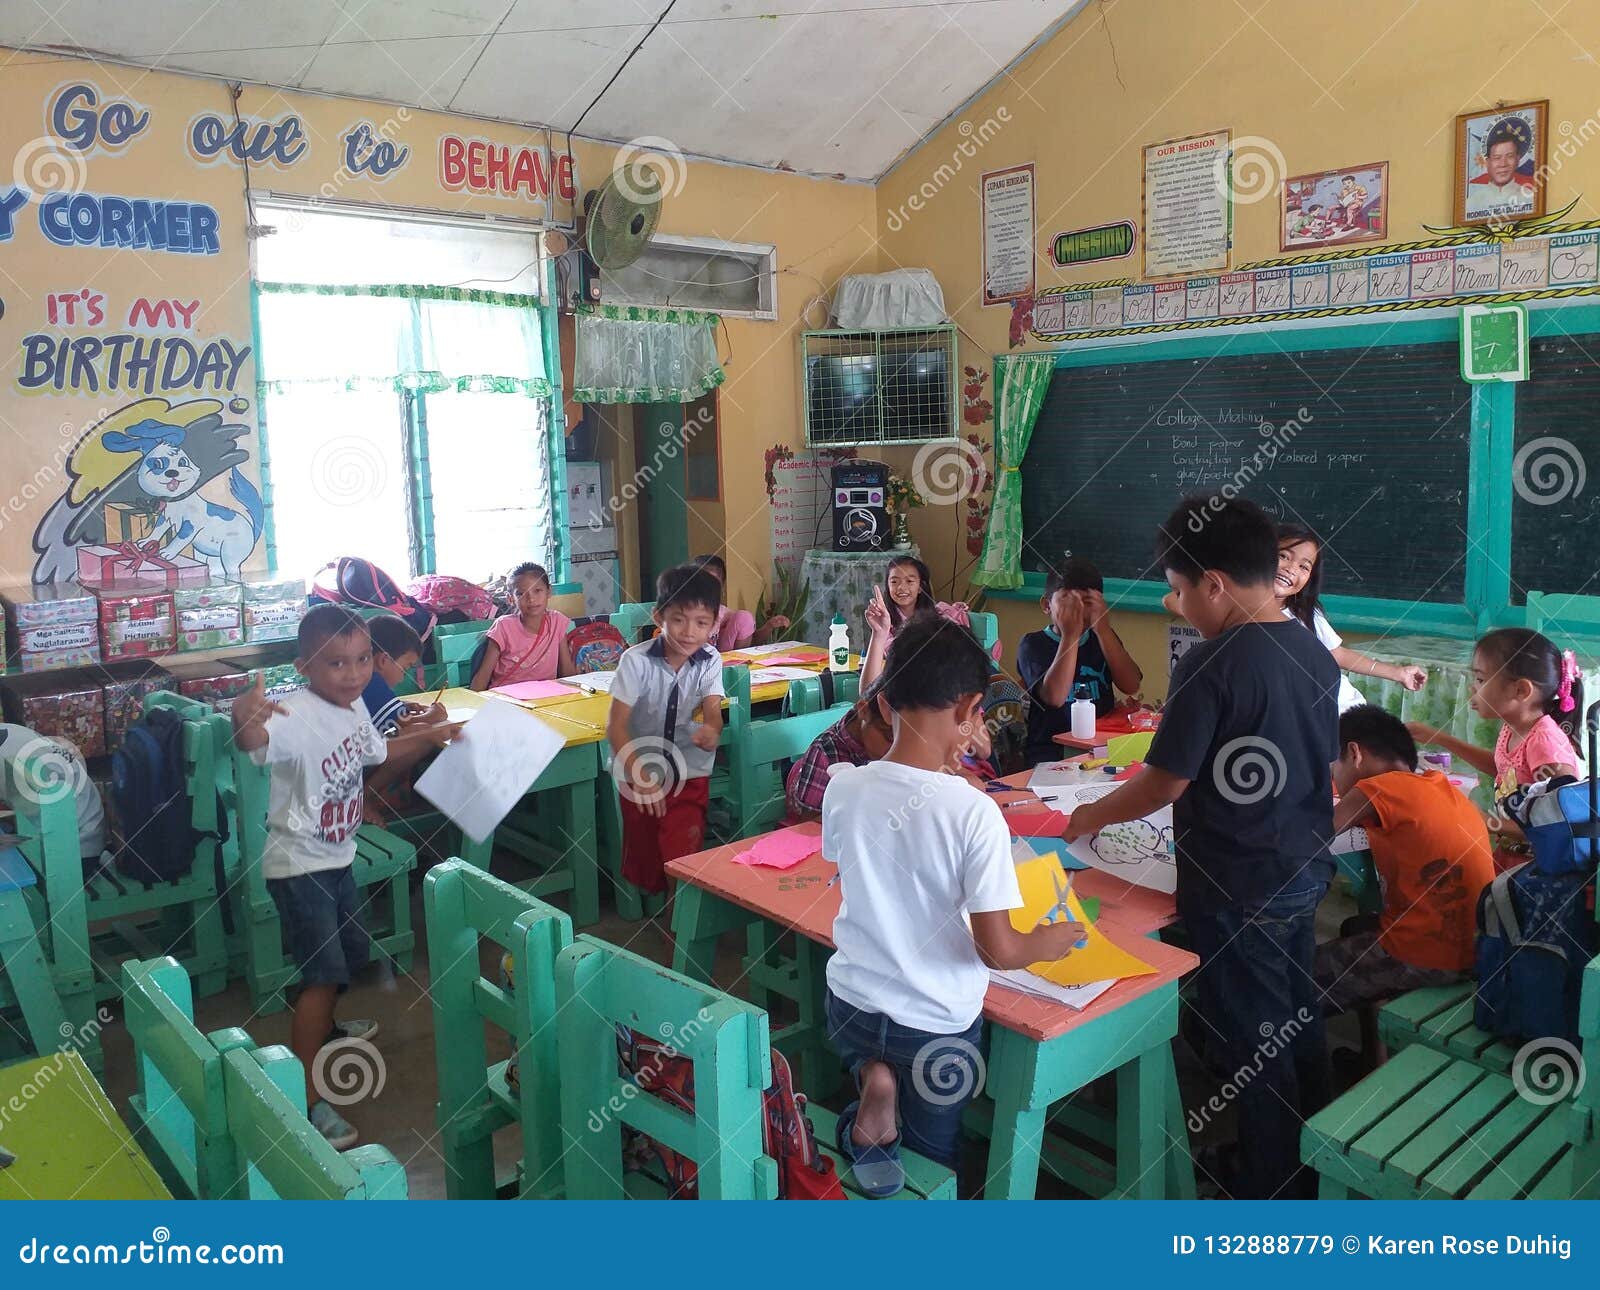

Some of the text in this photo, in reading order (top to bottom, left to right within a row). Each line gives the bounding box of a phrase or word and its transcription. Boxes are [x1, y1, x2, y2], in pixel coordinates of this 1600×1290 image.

[53, 85, 577, 200] Go out to BEHAVE
[1157, 139, 1216, 157] OUR MISSION
[39, 191, 220, 254] CORNER
[1060, 223, 1127, 264] MISSION
[1550, 233, 1598, 247] CURSIVE
[1412, 250, 1454, 262] CURSIVE
[1455, 244, 1500, 257] CURSIVE
[1330, 260, 1368, 271] CURSIVE
[1370, 255, 1411, 267] CURSIVE
[1255, 269, 1291, 280] CURSIVE
[1292, 264, 1329, 276] CURSIVE
[1186, 277, 1219, 288] CURSIVE
[1220, 273, 1254, 284] CURSIVE
[1123, 285, 1155, 295] CURSIVE
[1154, 282, 1186, 292] CURSIVE
[1065, 292, 1093, 301] CURSIVE
[47, 288, 201, 330] IT'S MY
[17, 334, 252, 395] BIRTHDAY
[1172, 435, 1199, 449] Bond
[778, 459, 810, 470] Academic
[1326, 452, 1367, 470] paper
[36, 629, 53, 639] Mga
[124, 631, 161, 641] Pictures
